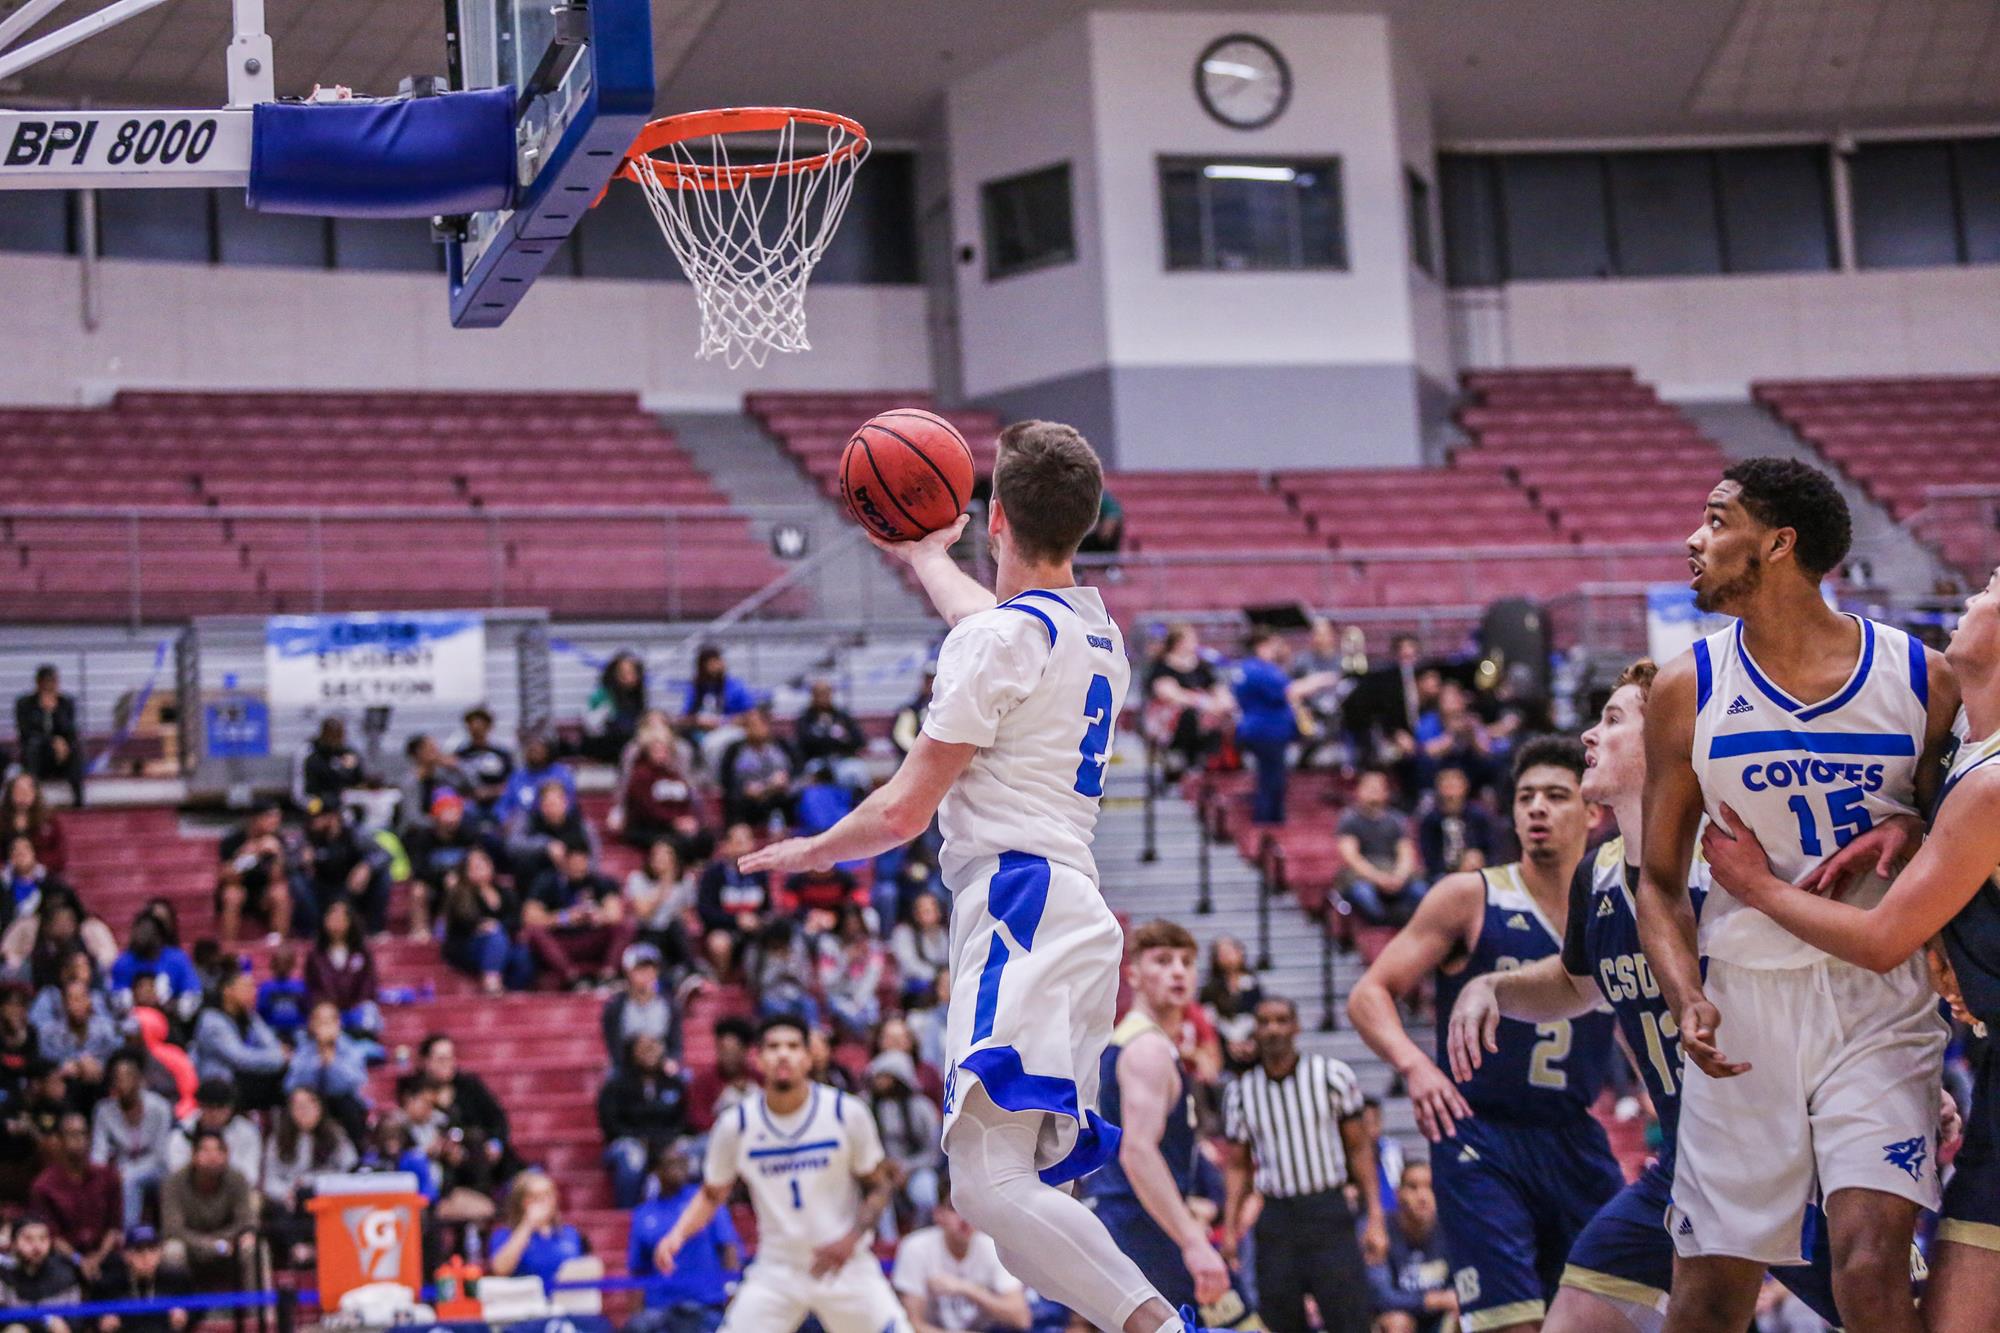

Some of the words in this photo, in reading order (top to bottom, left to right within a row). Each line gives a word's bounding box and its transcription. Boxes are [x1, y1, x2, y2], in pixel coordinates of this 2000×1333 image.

[4, 120, 99, 166] BPI
[107, 119, 217, 165] 8000
[1726, 704, 1755, 716] adidas
[1073, 673, 1113, 798] 2
[1741, 758, 1885, 793] COYOTES
[1787, 785, 1874, 857] 15
[1528, 1018, 1573, 1090] 2
[789, 1179, 803, 1210] 1
[364, 1209, 397, 1249] G
